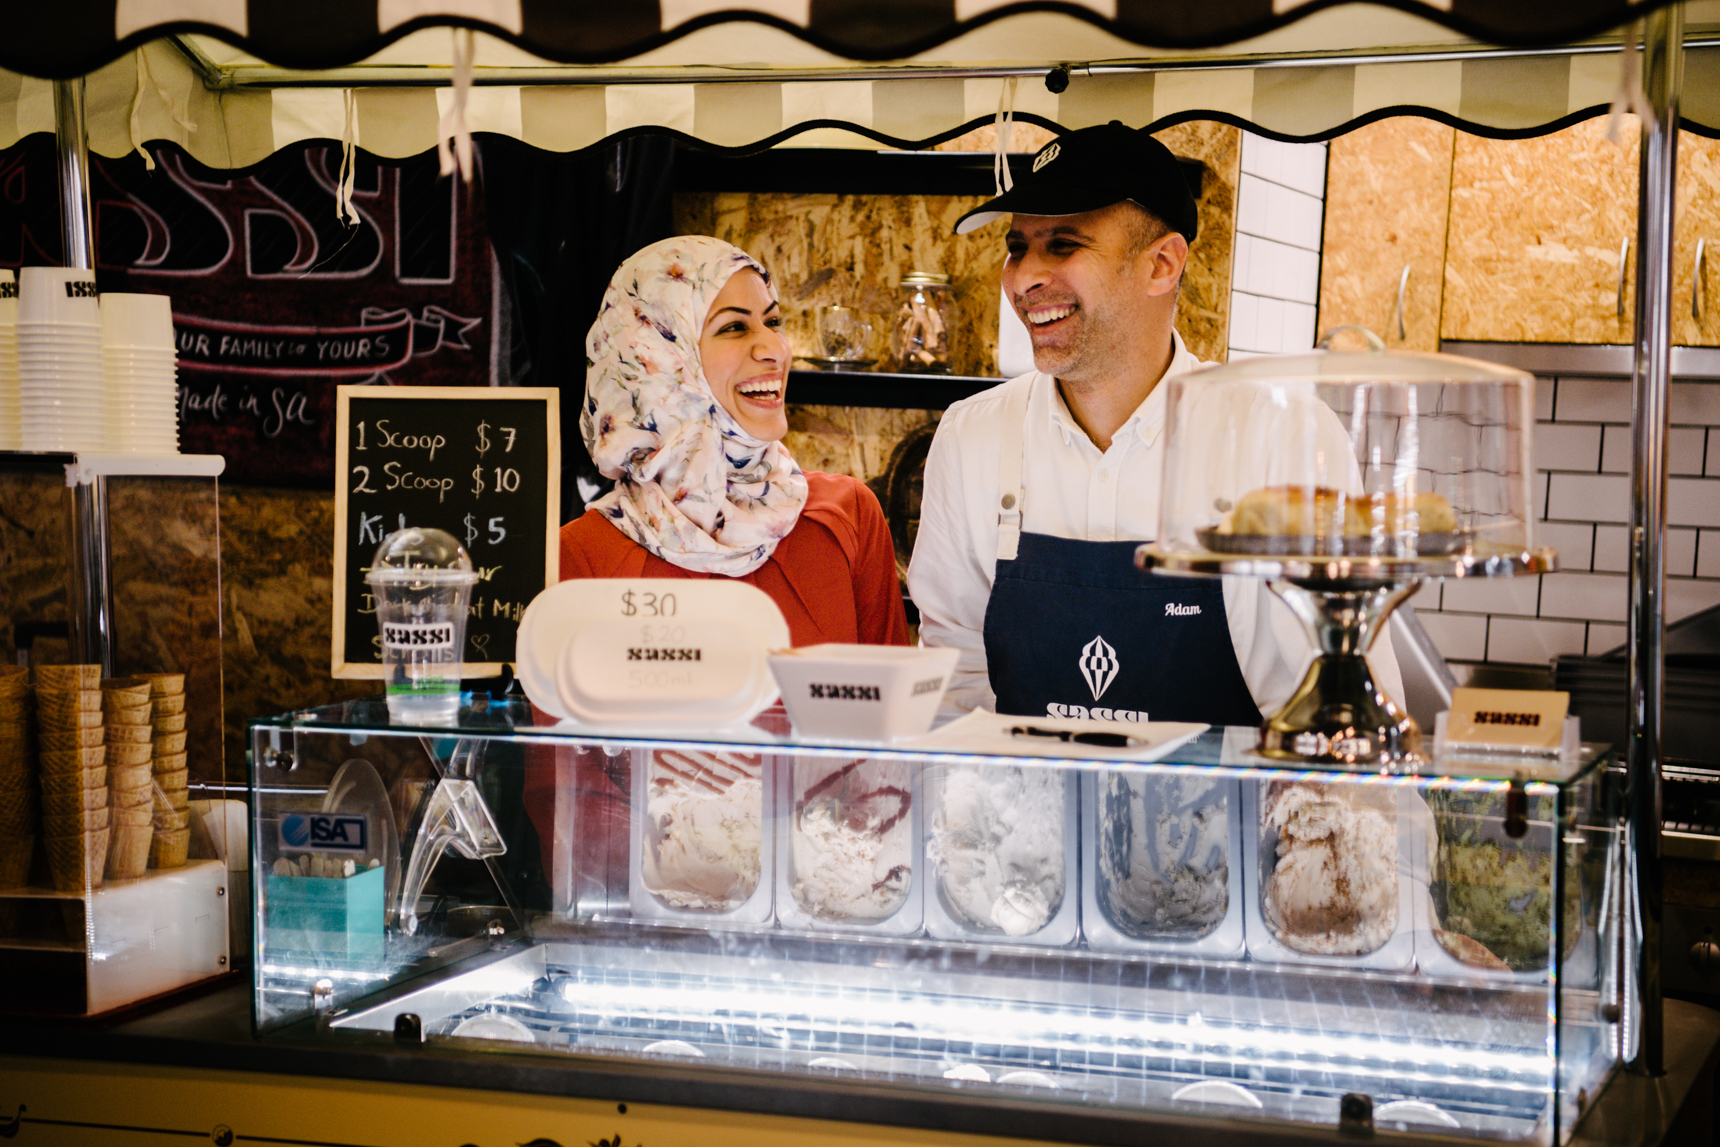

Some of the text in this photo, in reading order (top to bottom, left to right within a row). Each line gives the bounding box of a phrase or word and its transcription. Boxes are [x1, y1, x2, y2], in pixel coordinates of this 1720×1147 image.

[171, 330, 210, 357] UR
[219, 335, 284, 359] FAMILY
[317, 335, 389, 361] YOURS
[238, 385, 261, 416] in
[356, 421, 368, 450] 1
[376, 419, 446, 462] Scoop
[352, 465, 378, 494] 2
[383, 461, 454, 504] Scoop
[620, 588, 677, 617] $30
[1164, 602, 1202, 617] Adam
[310, 816, 349, 842] ISA
